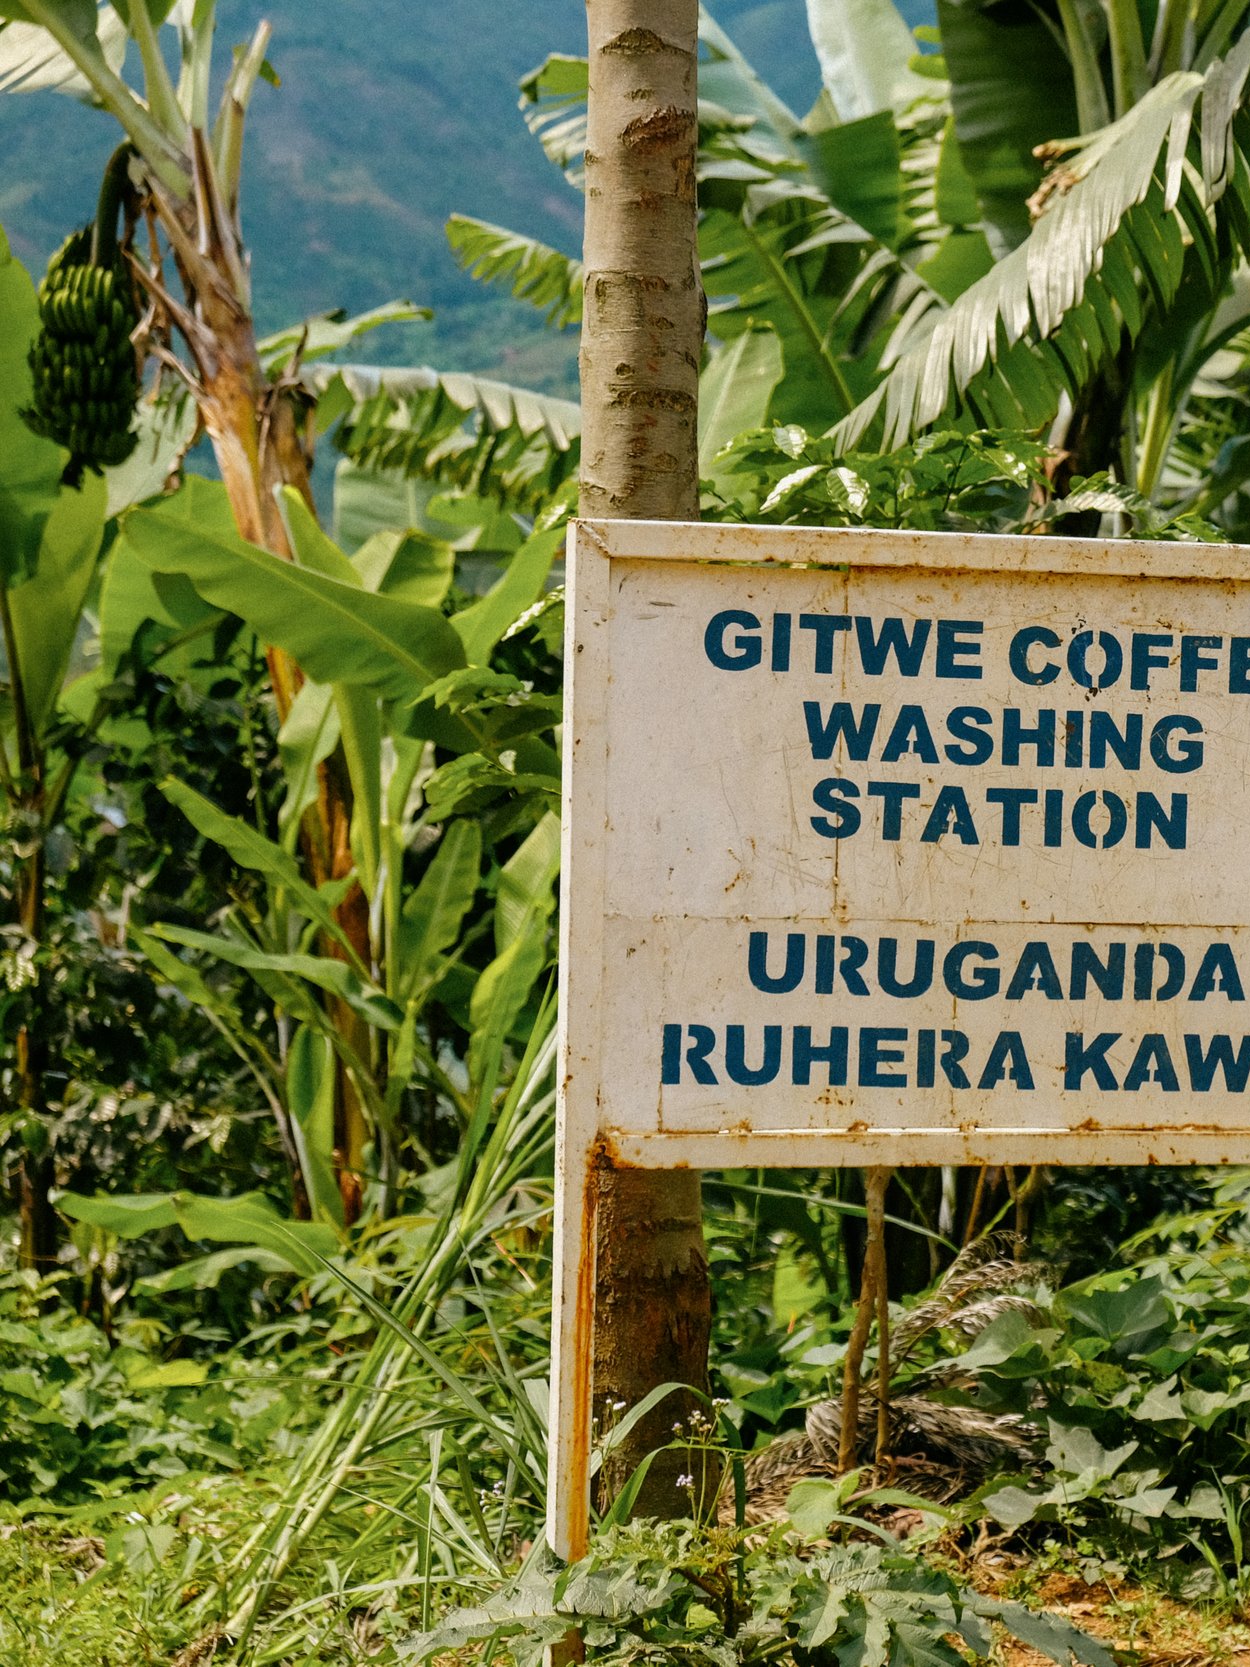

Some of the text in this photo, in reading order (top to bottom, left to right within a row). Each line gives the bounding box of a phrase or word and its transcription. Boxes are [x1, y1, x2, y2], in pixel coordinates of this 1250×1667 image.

[704, 609, 983, 680] GITWE
[804, 701, 1205, 774] WASHING
[810, 777, 1188, 850] STATION
[746, 931, 1245, 1002] URUGANDA
[661, 1023, 1034, 1090] RUHERA
